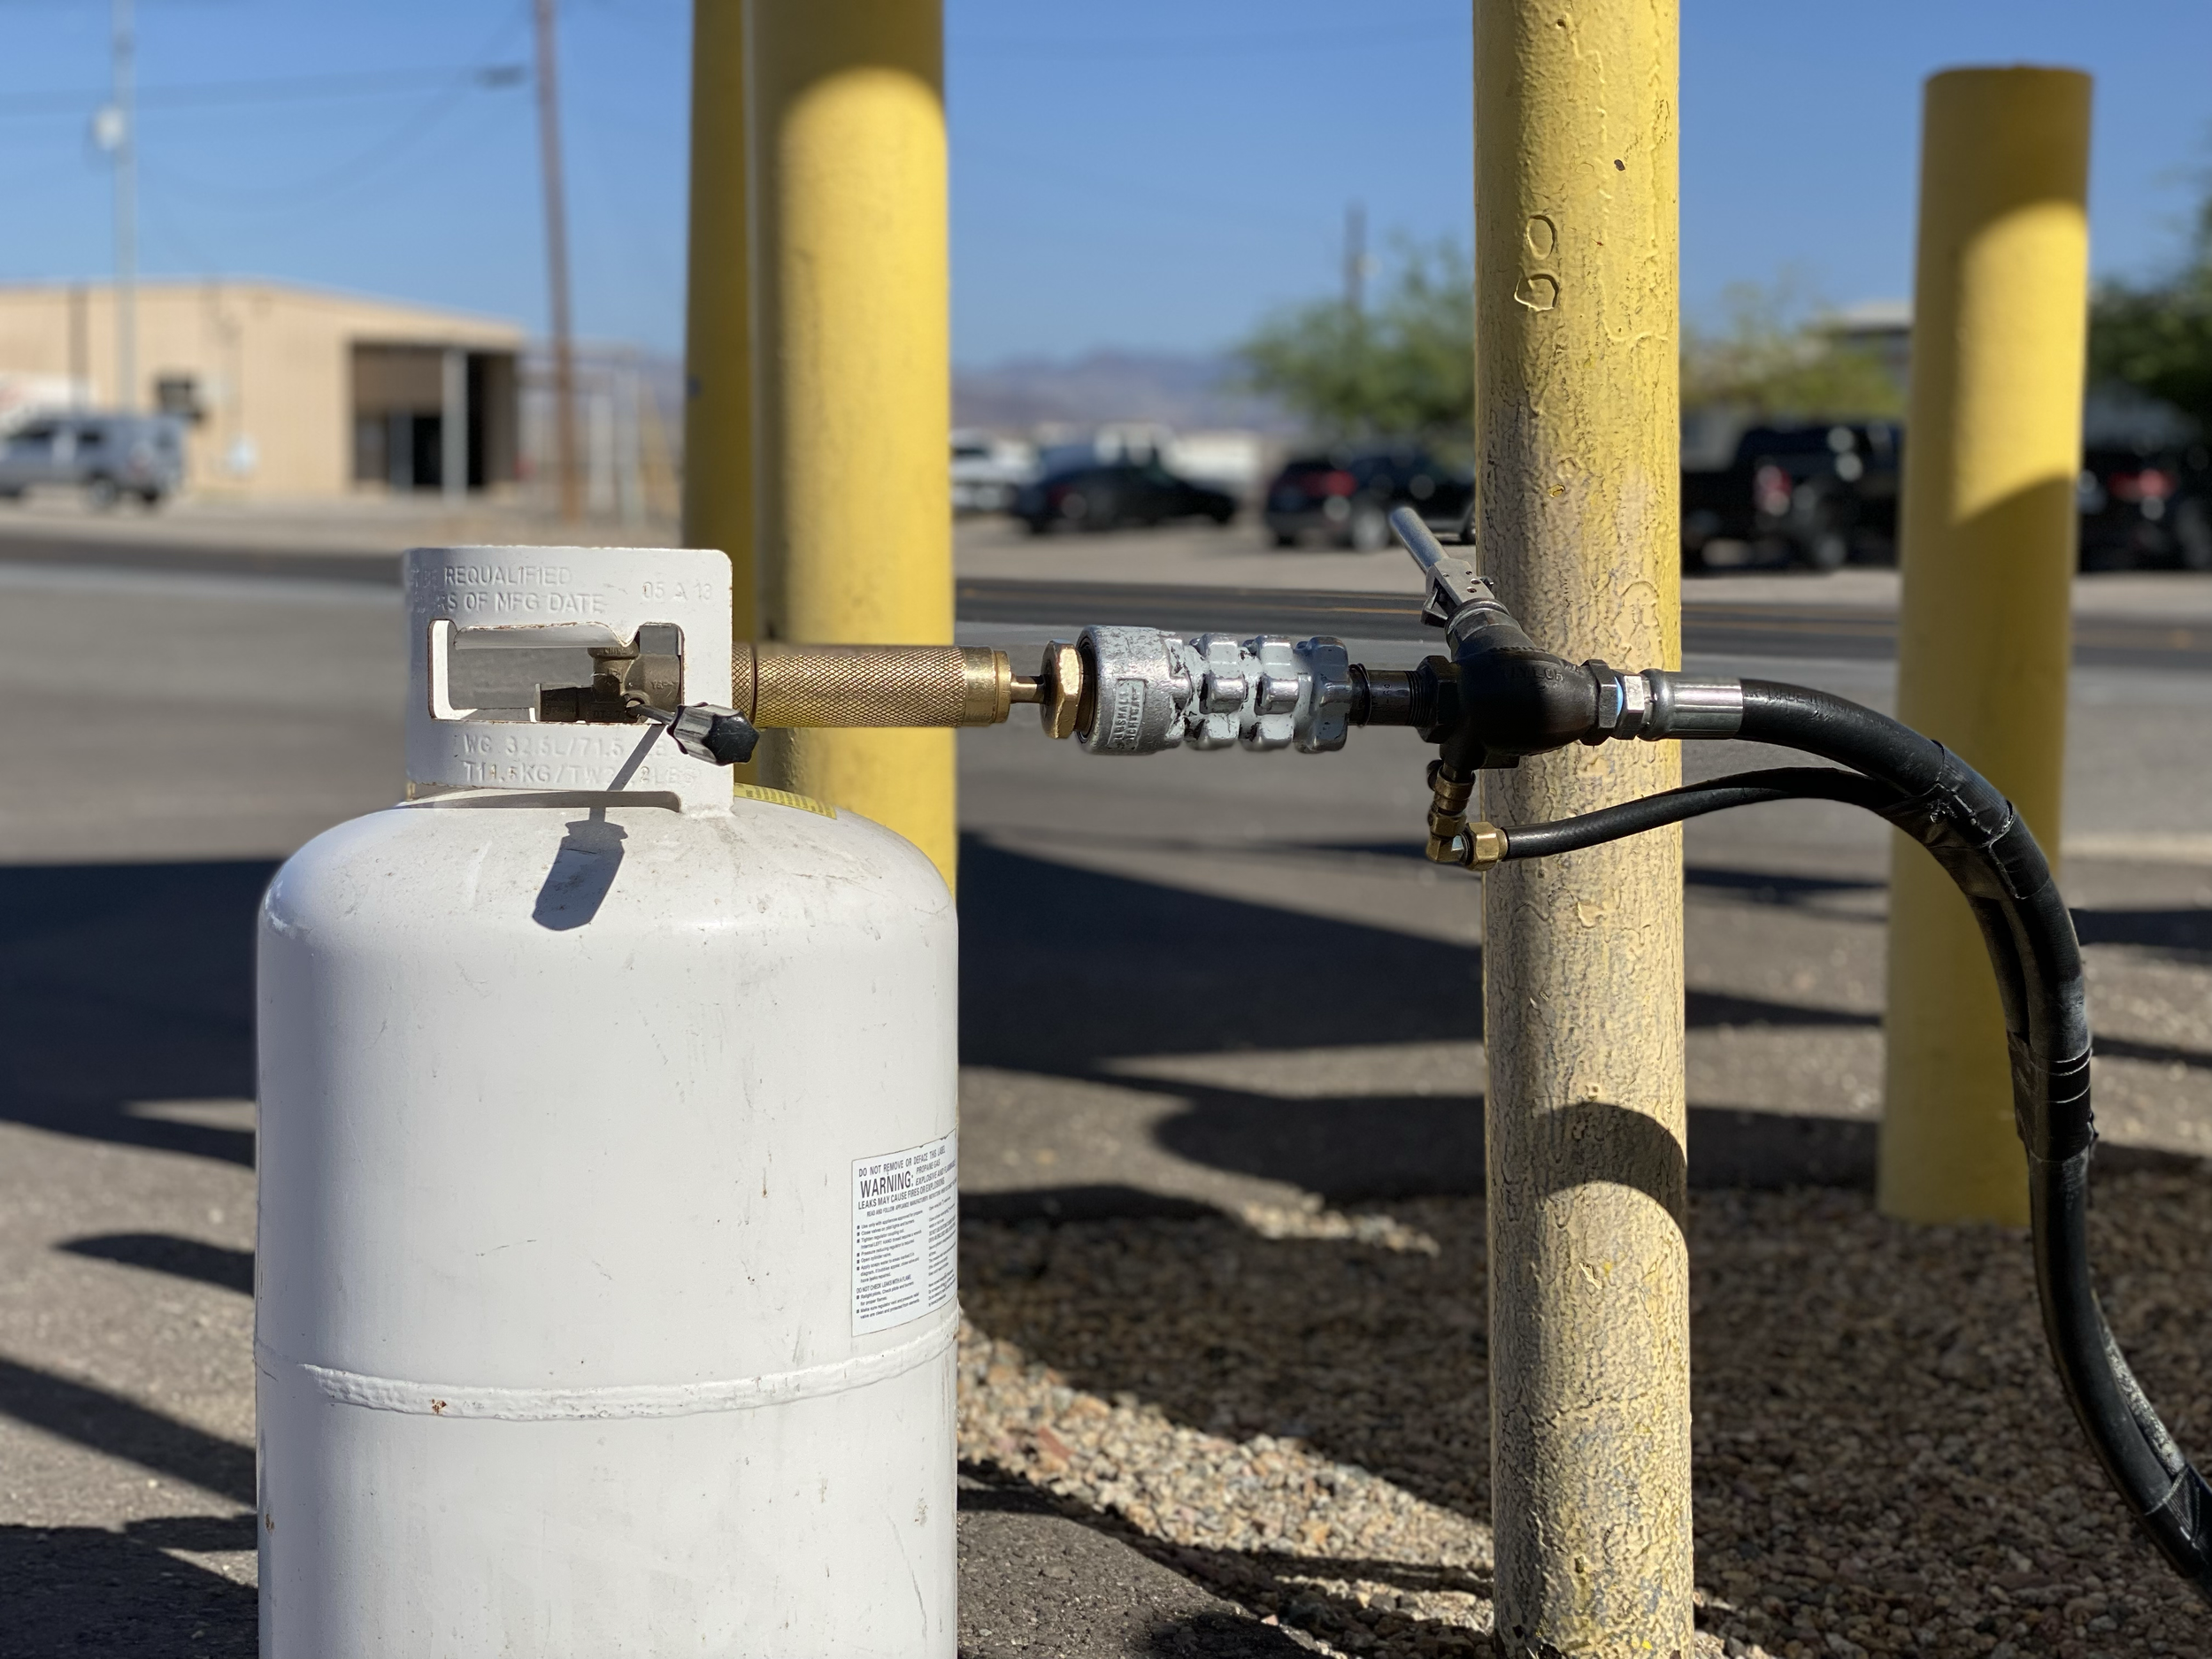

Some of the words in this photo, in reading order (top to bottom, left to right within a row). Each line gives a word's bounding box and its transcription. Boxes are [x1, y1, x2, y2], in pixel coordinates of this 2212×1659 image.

[444, 565, 572, 586] REQUALIFIED
[464, 591, 488, 611] OF
[494, 592, 541, 612] MFG
[548, 592, 608, 613] DATE
[858, 1168, 867, 1177] DO
[870, 1165, 881, 1175] NOT
[884, 1160, 903, 1172] REMOVE
[905, 1158, 911, 1167] OR
[914, 1153, 928, 1164] DEFACE
[916, 1163, 933, 1174] PROPANE
[860, 1171, 913, 1198] WARNING:
[916, 1171, 937, 1186] EXPLOSIVE
[858, 1199, 877, 1210] LEAKS
[878, 1196, 890, 1205] MAY
[891, 1192, 907, 1202] CAUSE
[908, 1187, 919, 1198] FIRES
